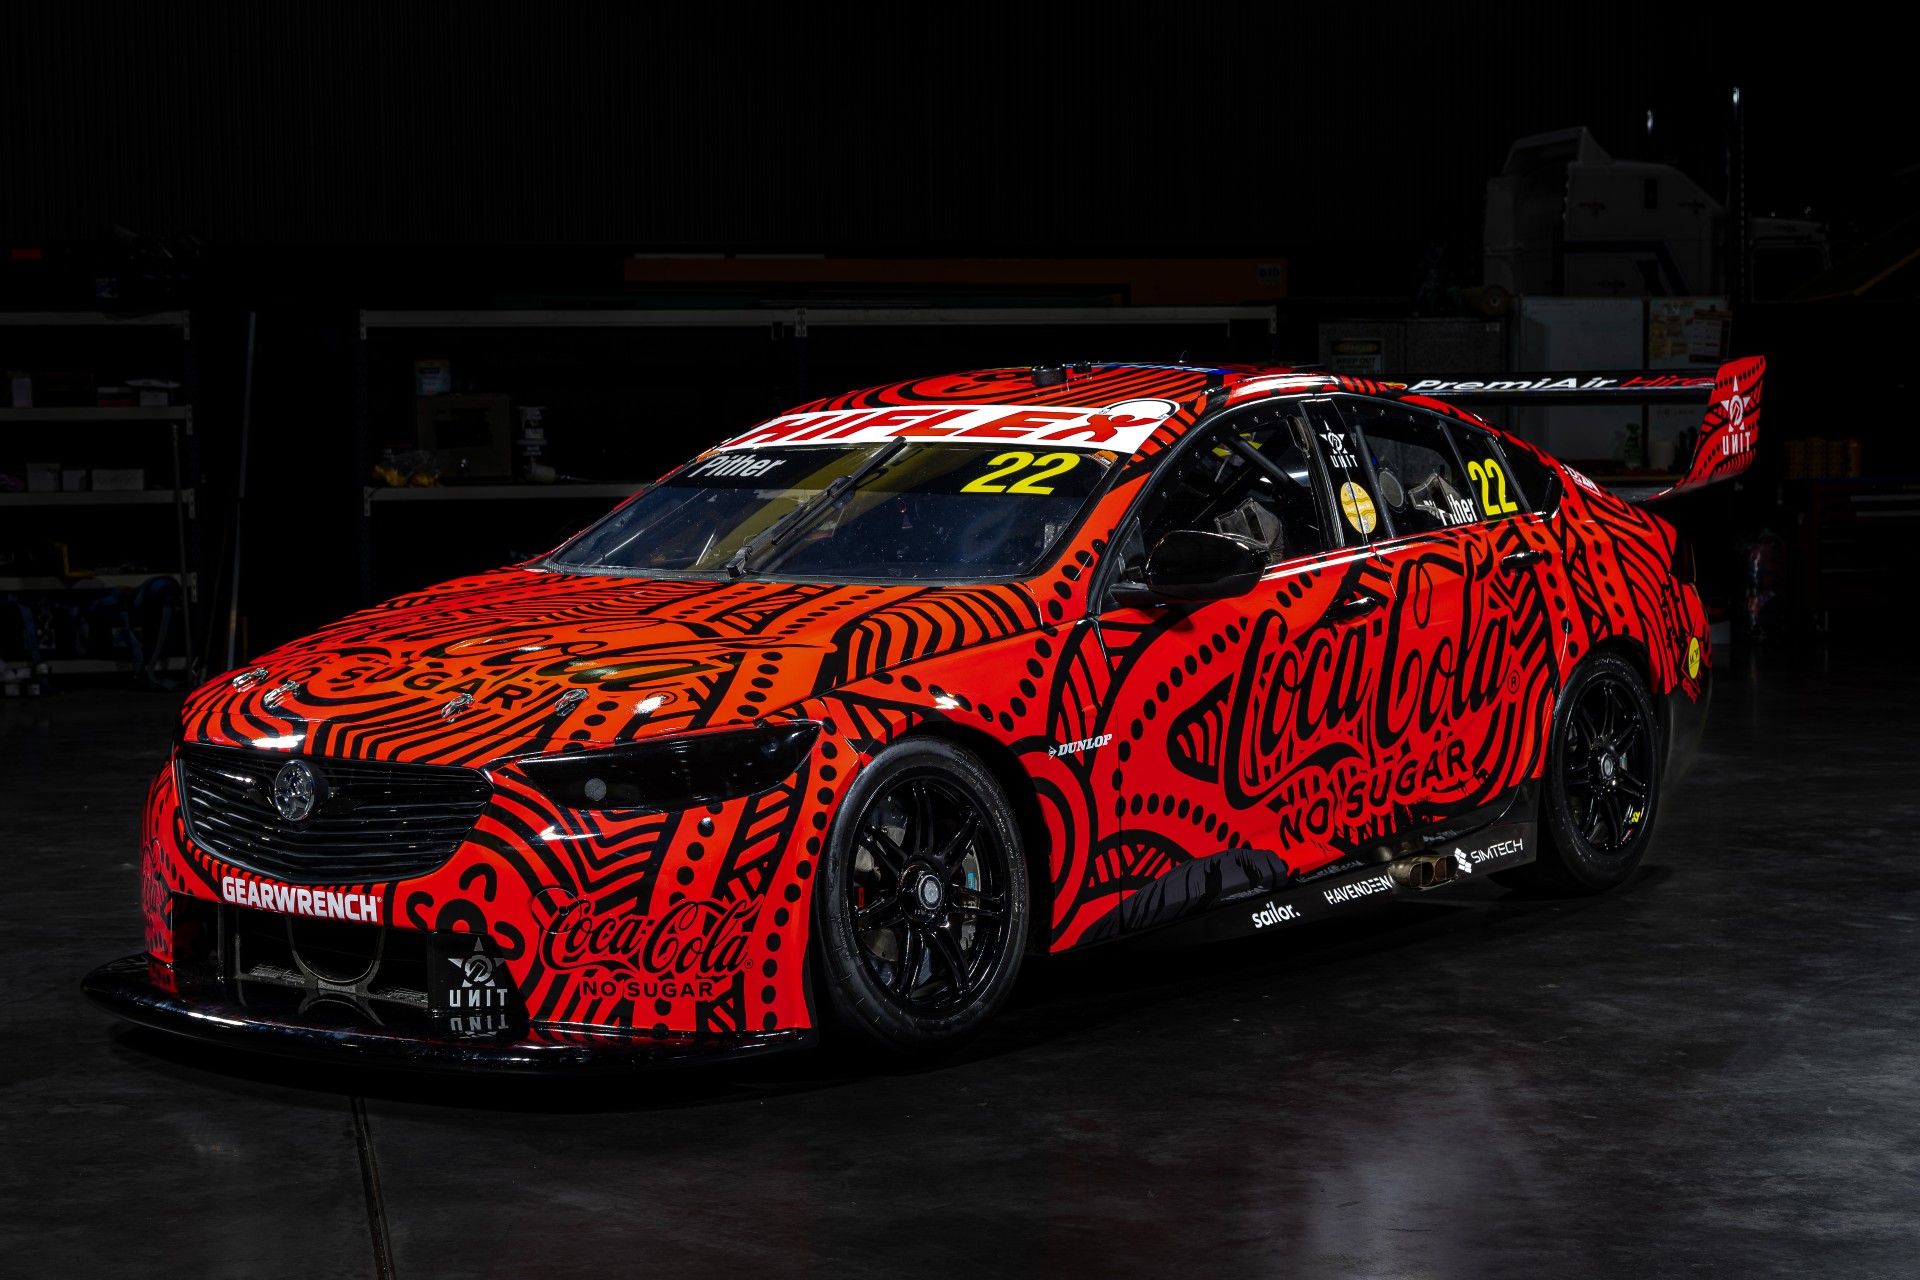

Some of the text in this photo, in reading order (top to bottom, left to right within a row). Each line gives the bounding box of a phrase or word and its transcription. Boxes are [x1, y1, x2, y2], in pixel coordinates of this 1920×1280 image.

[1408, 376, 1618, 391] PremiAir
[1722, 431, 1751, 455] UNIT
[687, 453, 787, 478] Pither
[959, 451, 1081, 496] 22
[1467, 458, 1519, 517] 22
[327, 666, 533, 710] SUGAR
[1056, 733, 1113, 757] DUNLOP
[1280, 739, 1468, 850] NO SUGAR
[1470, 838, 1523, 863] SIMTECH
[221, 875, 379, 923] GEARWRENCH
[543, 898, 763, 974] Coca-Cola
[583, 981, 713, 998] NO SUGAR
